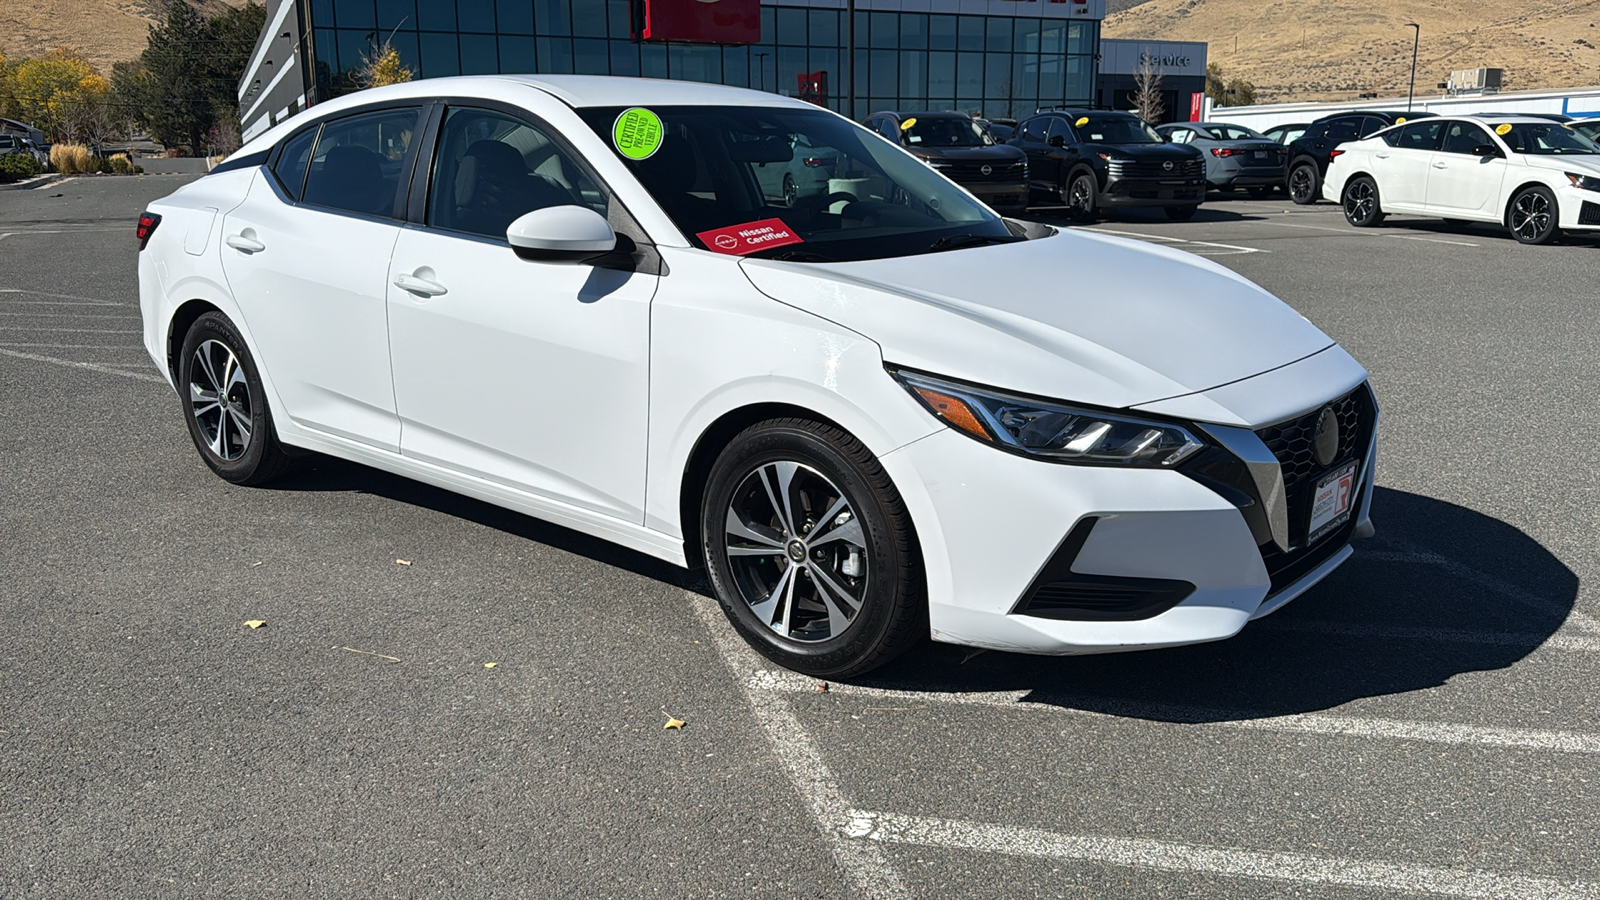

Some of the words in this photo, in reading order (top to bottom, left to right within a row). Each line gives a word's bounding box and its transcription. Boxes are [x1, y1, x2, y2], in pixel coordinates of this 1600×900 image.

[1139, 52, 1191, 67] Service
[620, 112, 639, 149] CERTIFIED
[633, 117, 649, 149] PRE-OWNED
[644, 123, 658, 146] VEHICLE
[738, 225, 774, 238] Nissan
[746, 231, 790, 245] Certified
